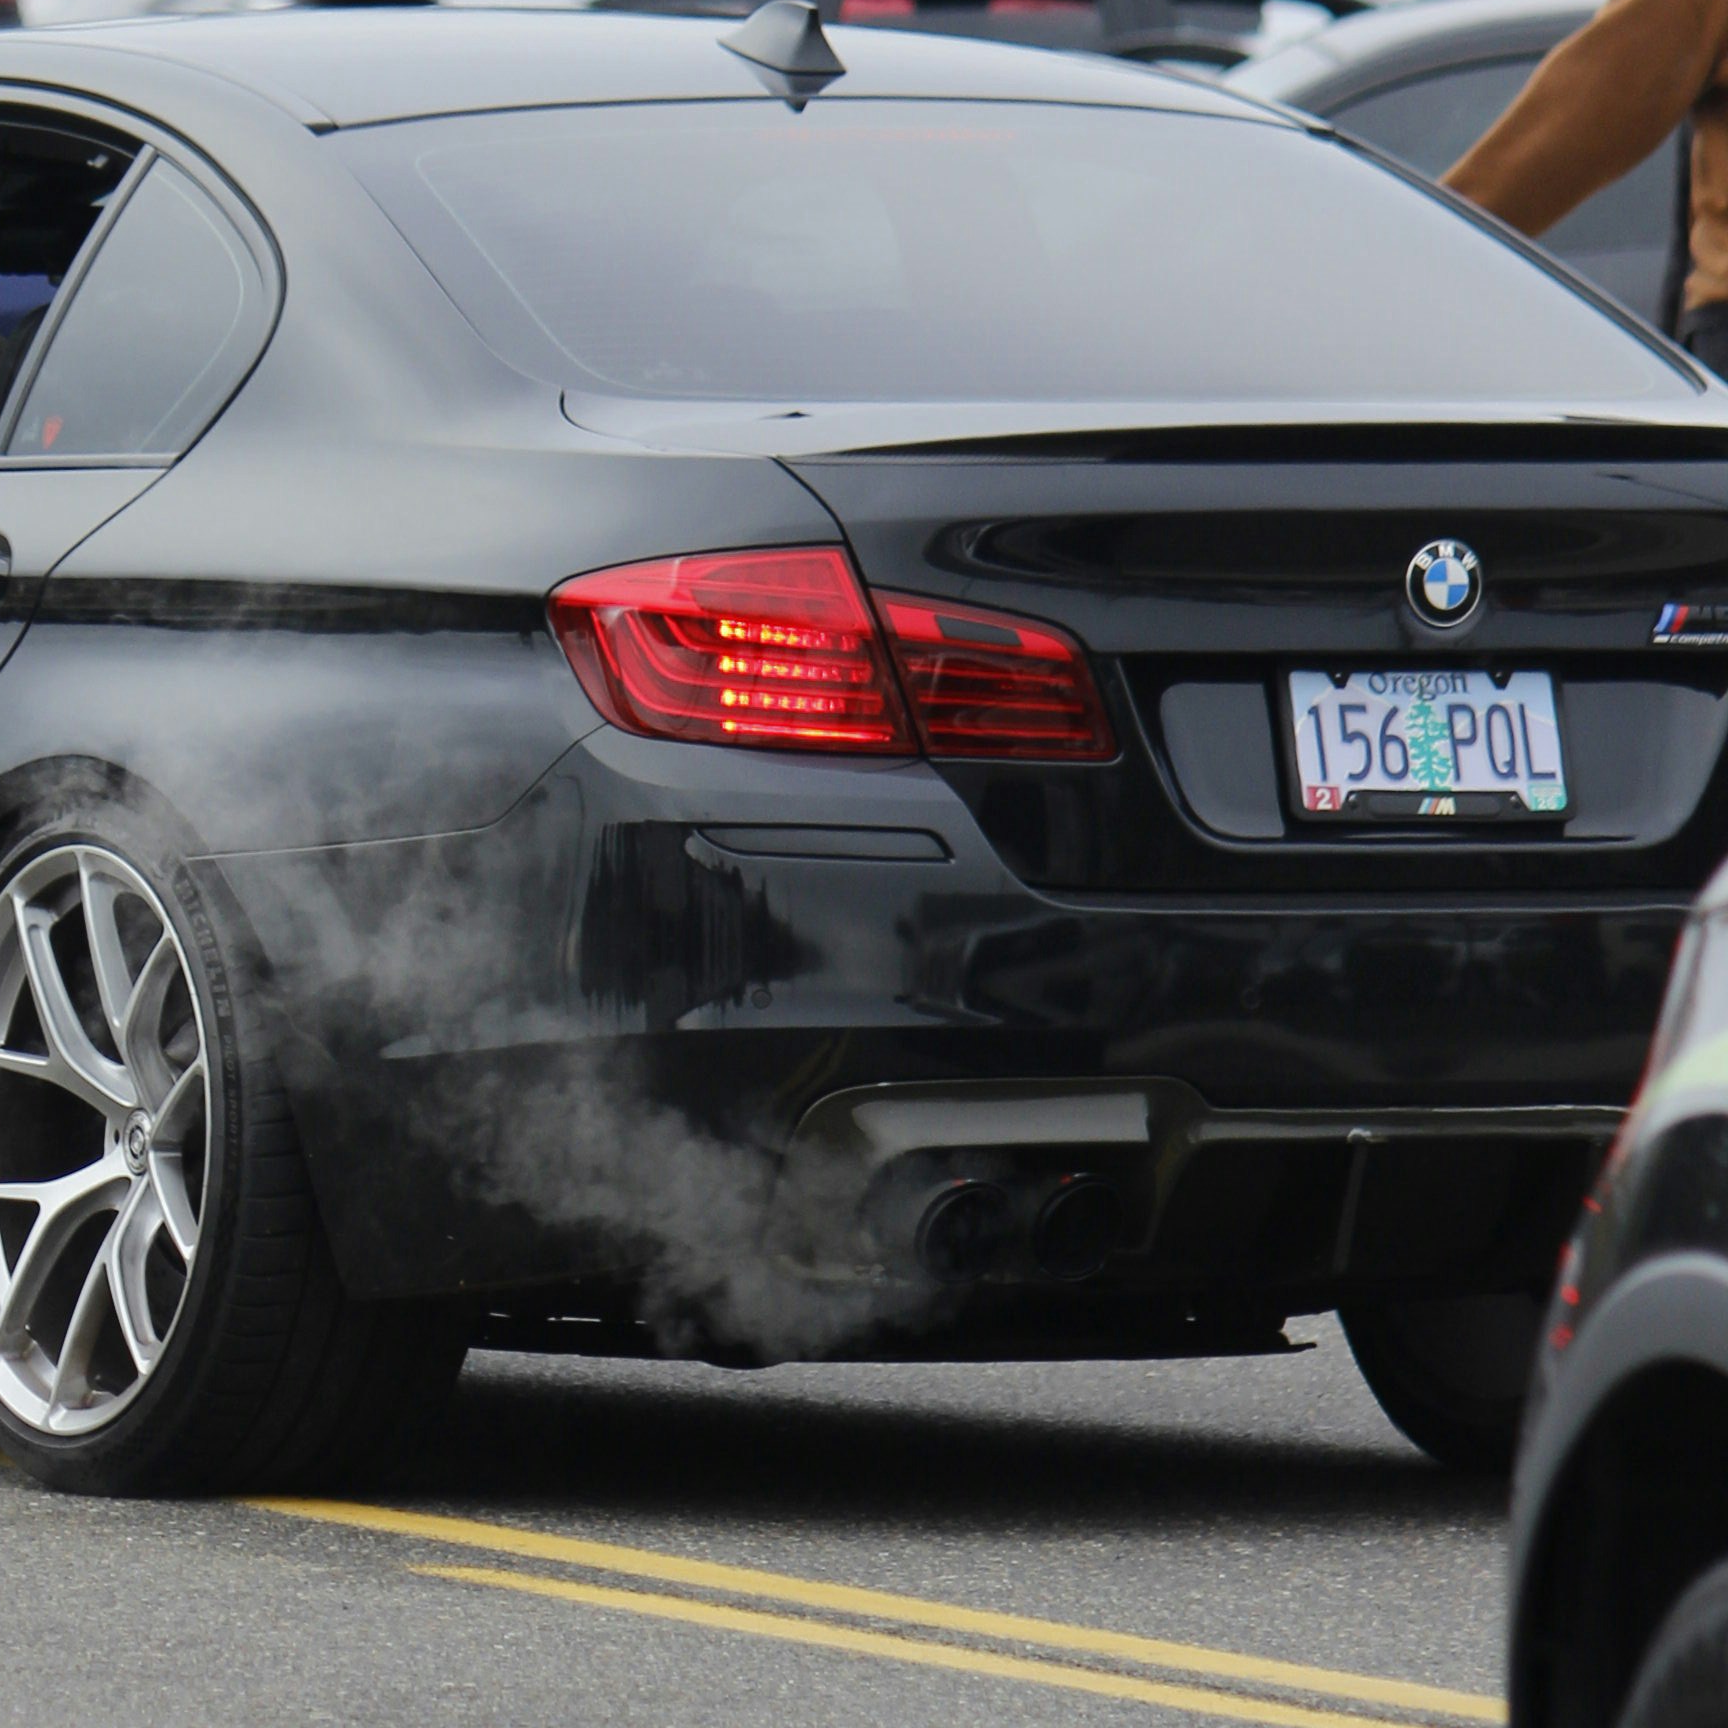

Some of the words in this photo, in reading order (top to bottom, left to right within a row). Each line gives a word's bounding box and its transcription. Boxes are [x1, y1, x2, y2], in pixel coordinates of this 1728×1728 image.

[1415, 541, 1479, 571] BMW
[1368, 672, 1470, 701] Oregon
[1308, 703, 1410, 783] 156
[1447, 703, 1557, 783] PQL
[1315, 788, 1334, 811] 2
[175, 878, 232, 1017] MICHELIN
